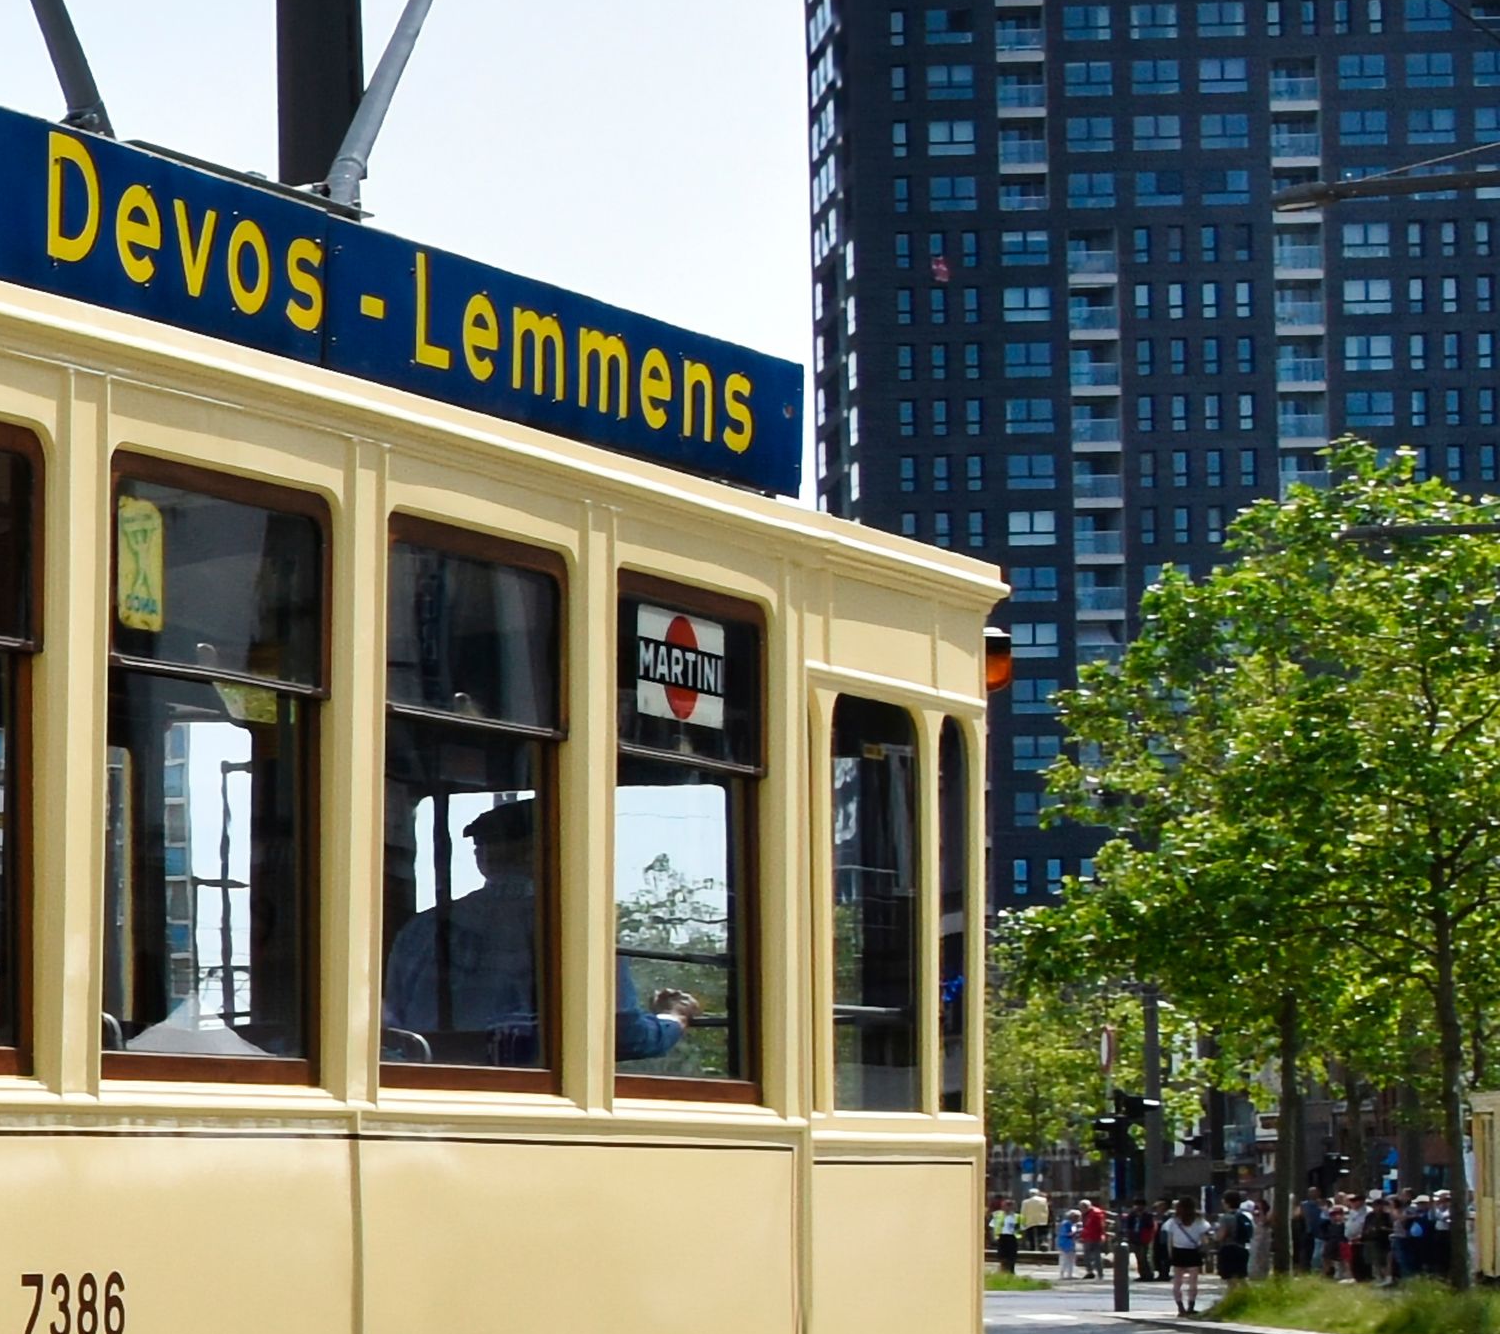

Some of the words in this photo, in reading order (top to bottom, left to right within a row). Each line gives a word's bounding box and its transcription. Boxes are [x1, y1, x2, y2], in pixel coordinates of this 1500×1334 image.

[47, 130, 323, 332] Devos
[415, 251, 753, 454] Lemmens
[640, 640, 723, 694] MARTINI
